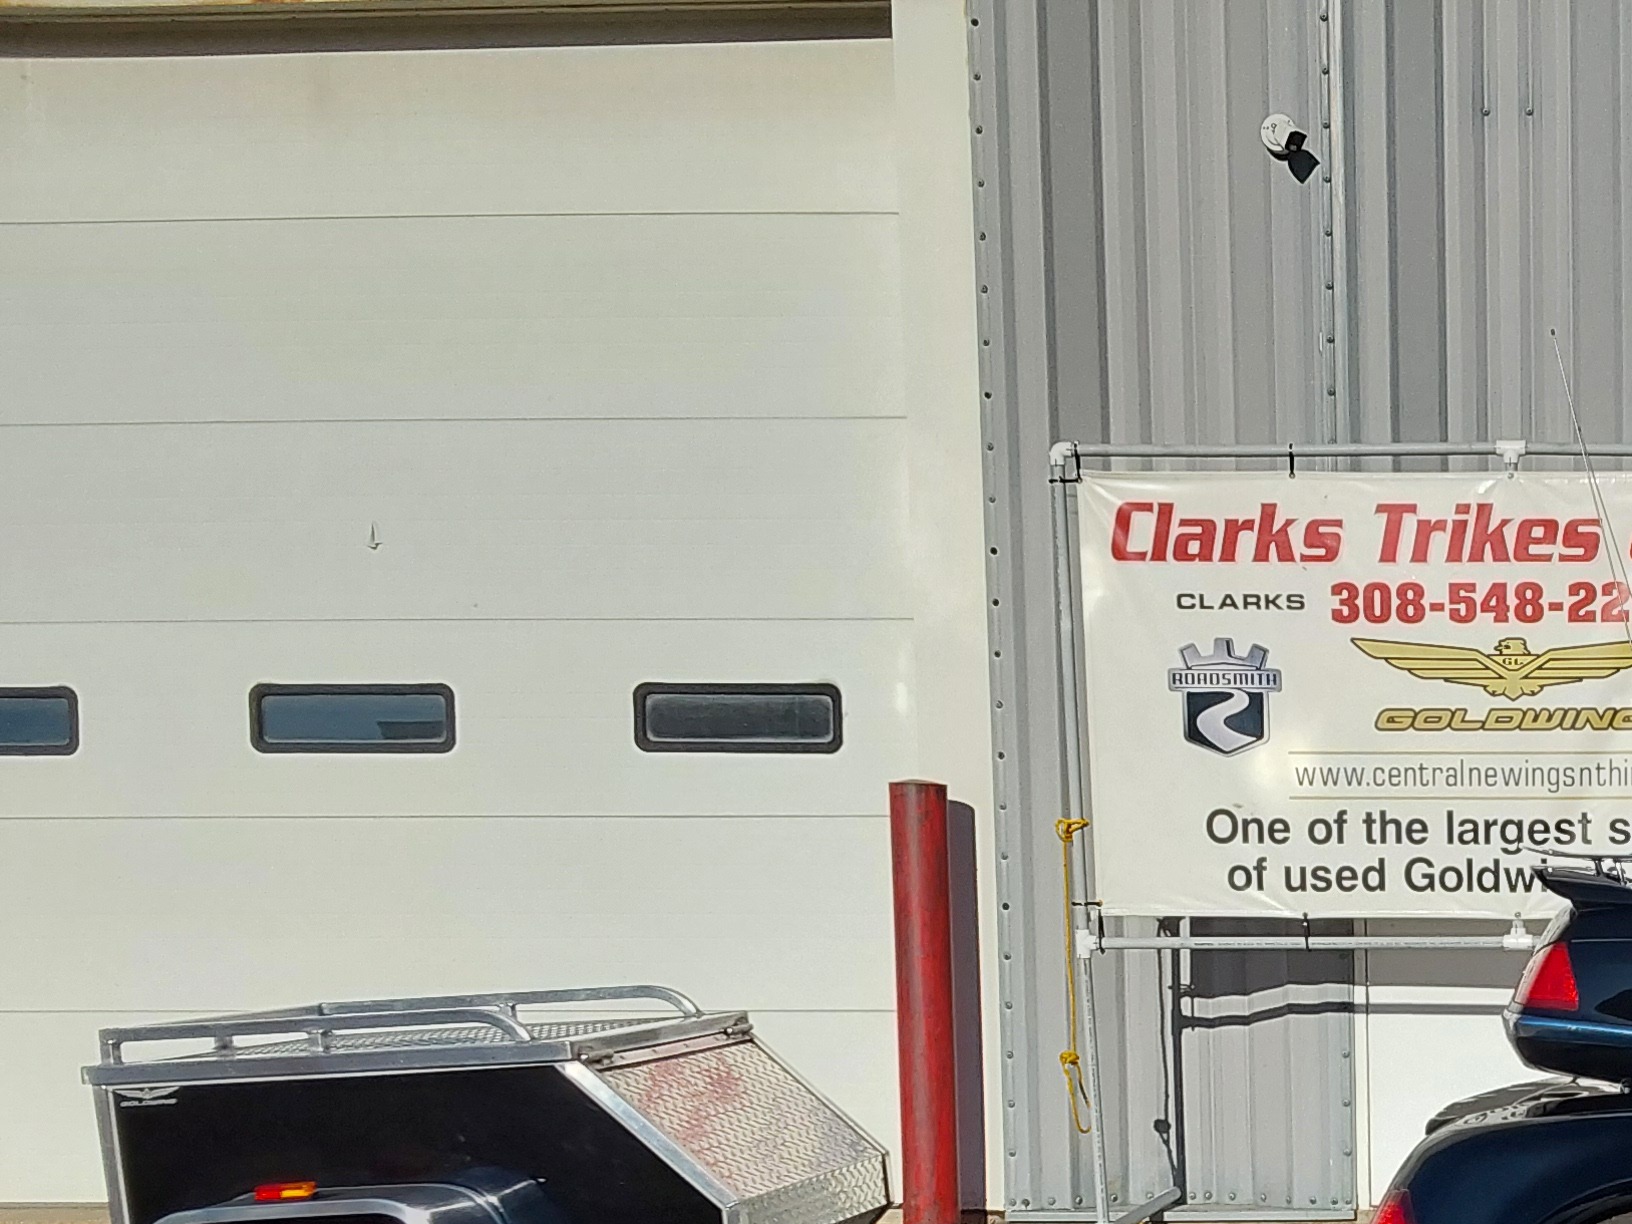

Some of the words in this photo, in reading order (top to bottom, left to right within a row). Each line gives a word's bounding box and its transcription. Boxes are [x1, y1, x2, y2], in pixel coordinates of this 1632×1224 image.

[1110, 501, 1344, 563] Clarks
[1375, 502, 1602, 563] Trikes
[1176, 593, 1306, 611] CLARKS
[1172, 672, 1277, 686] ROADSMITH
[1206, 808, 1291, 844] One
[1307, 810, 1348, 845] of
[1362, 810, 1429, 845] the
[1447, 810, 1592, 855] largest
[1227, 857, 1268, 892] of
[1284, 858, 1386, 892] used
